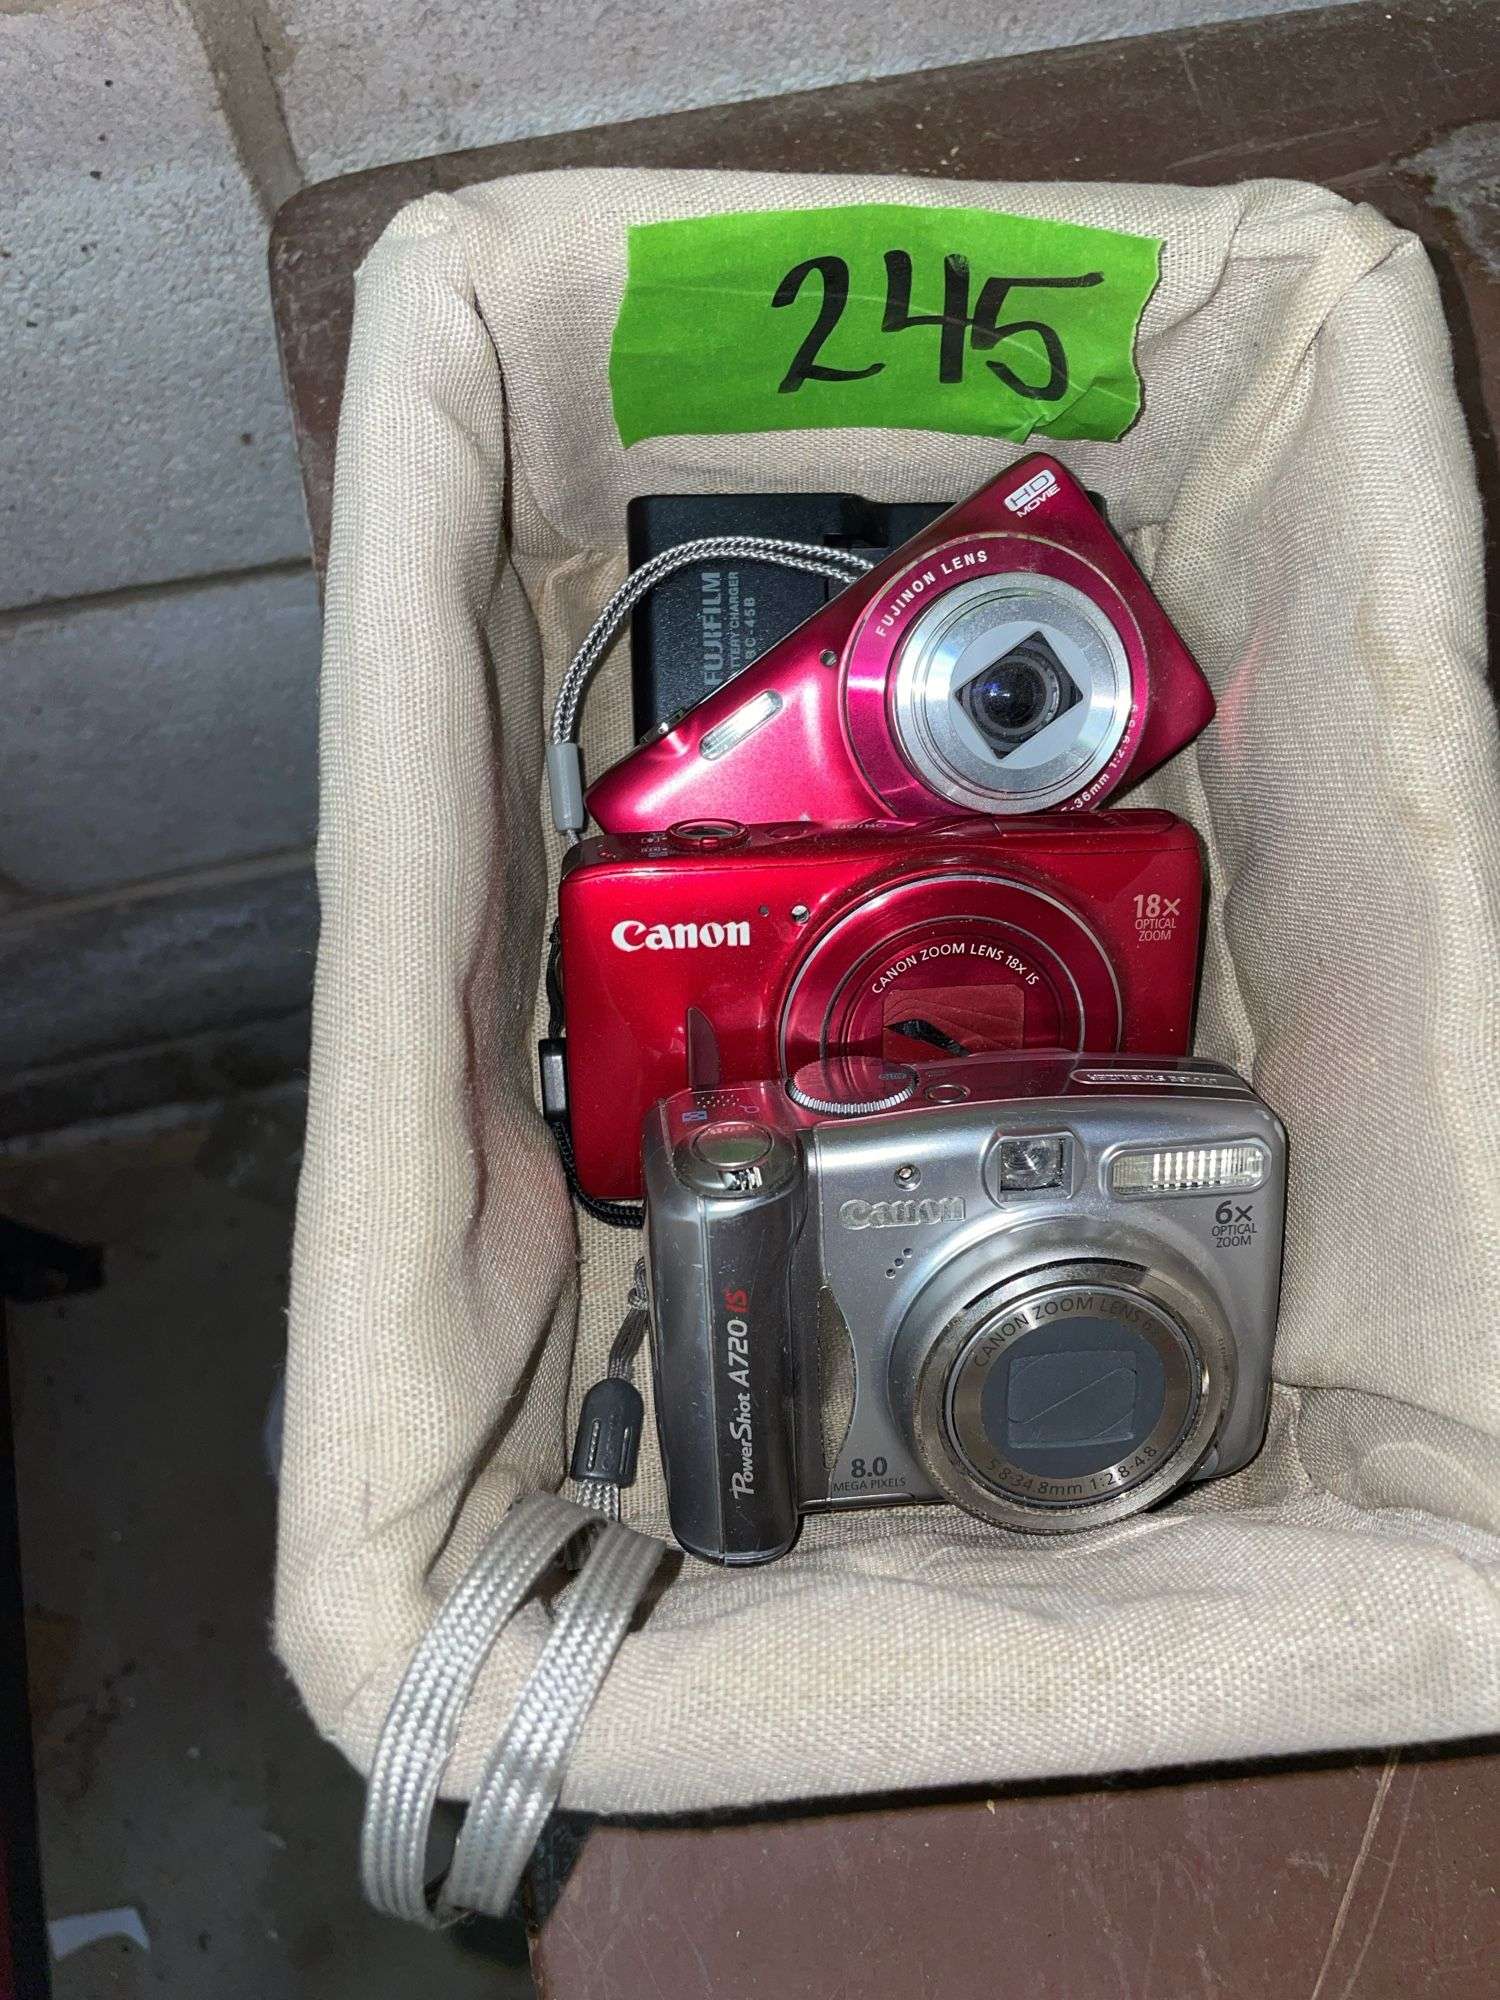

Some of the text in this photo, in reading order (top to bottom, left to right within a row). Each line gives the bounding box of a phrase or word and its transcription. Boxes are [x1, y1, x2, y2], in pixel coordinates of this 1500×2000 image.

[771, 249, 1104, 401] 245
[1008, 473, 1051, 507] HD
[1016, 484, 1061, 517] MOVIE
[875, 550, 988, 637] FUJINON LENS
[702, 572, 724, 686] FUJIFILM
[728, 571, 741, 669] TTERY CHARGER
[1061, 773, 1111, 811] -36mm
[611, 919, 750, 952] Canon
[1134, 917, 1177, 930] OPTICAL
[1138, 929, 1172, 942] ZOOM
[872, 955, 917, 994] CANON
[920, 942, 965, 961] ZOOM
[970, 943, 1004, 961] LENS
[1025, 972, 1040, 986] IS
[839, 1196, 967, 1230] Canon
[1211, 1222, 1258, 1237] OPTICAL
[1216, 1234, 1252, 1248] ZOOM
[974, 1296, 1144, 1368] CANON ZOOM LENS
[725, 1288, 755, 1500] PowerShot A720 IS
[850, 1456, 888, 1478] 8.0
[1089, 1445, 1158, 1491] 1:2.8-4.8
[833, 1477, 906, 1492] MEGA PIXELS
